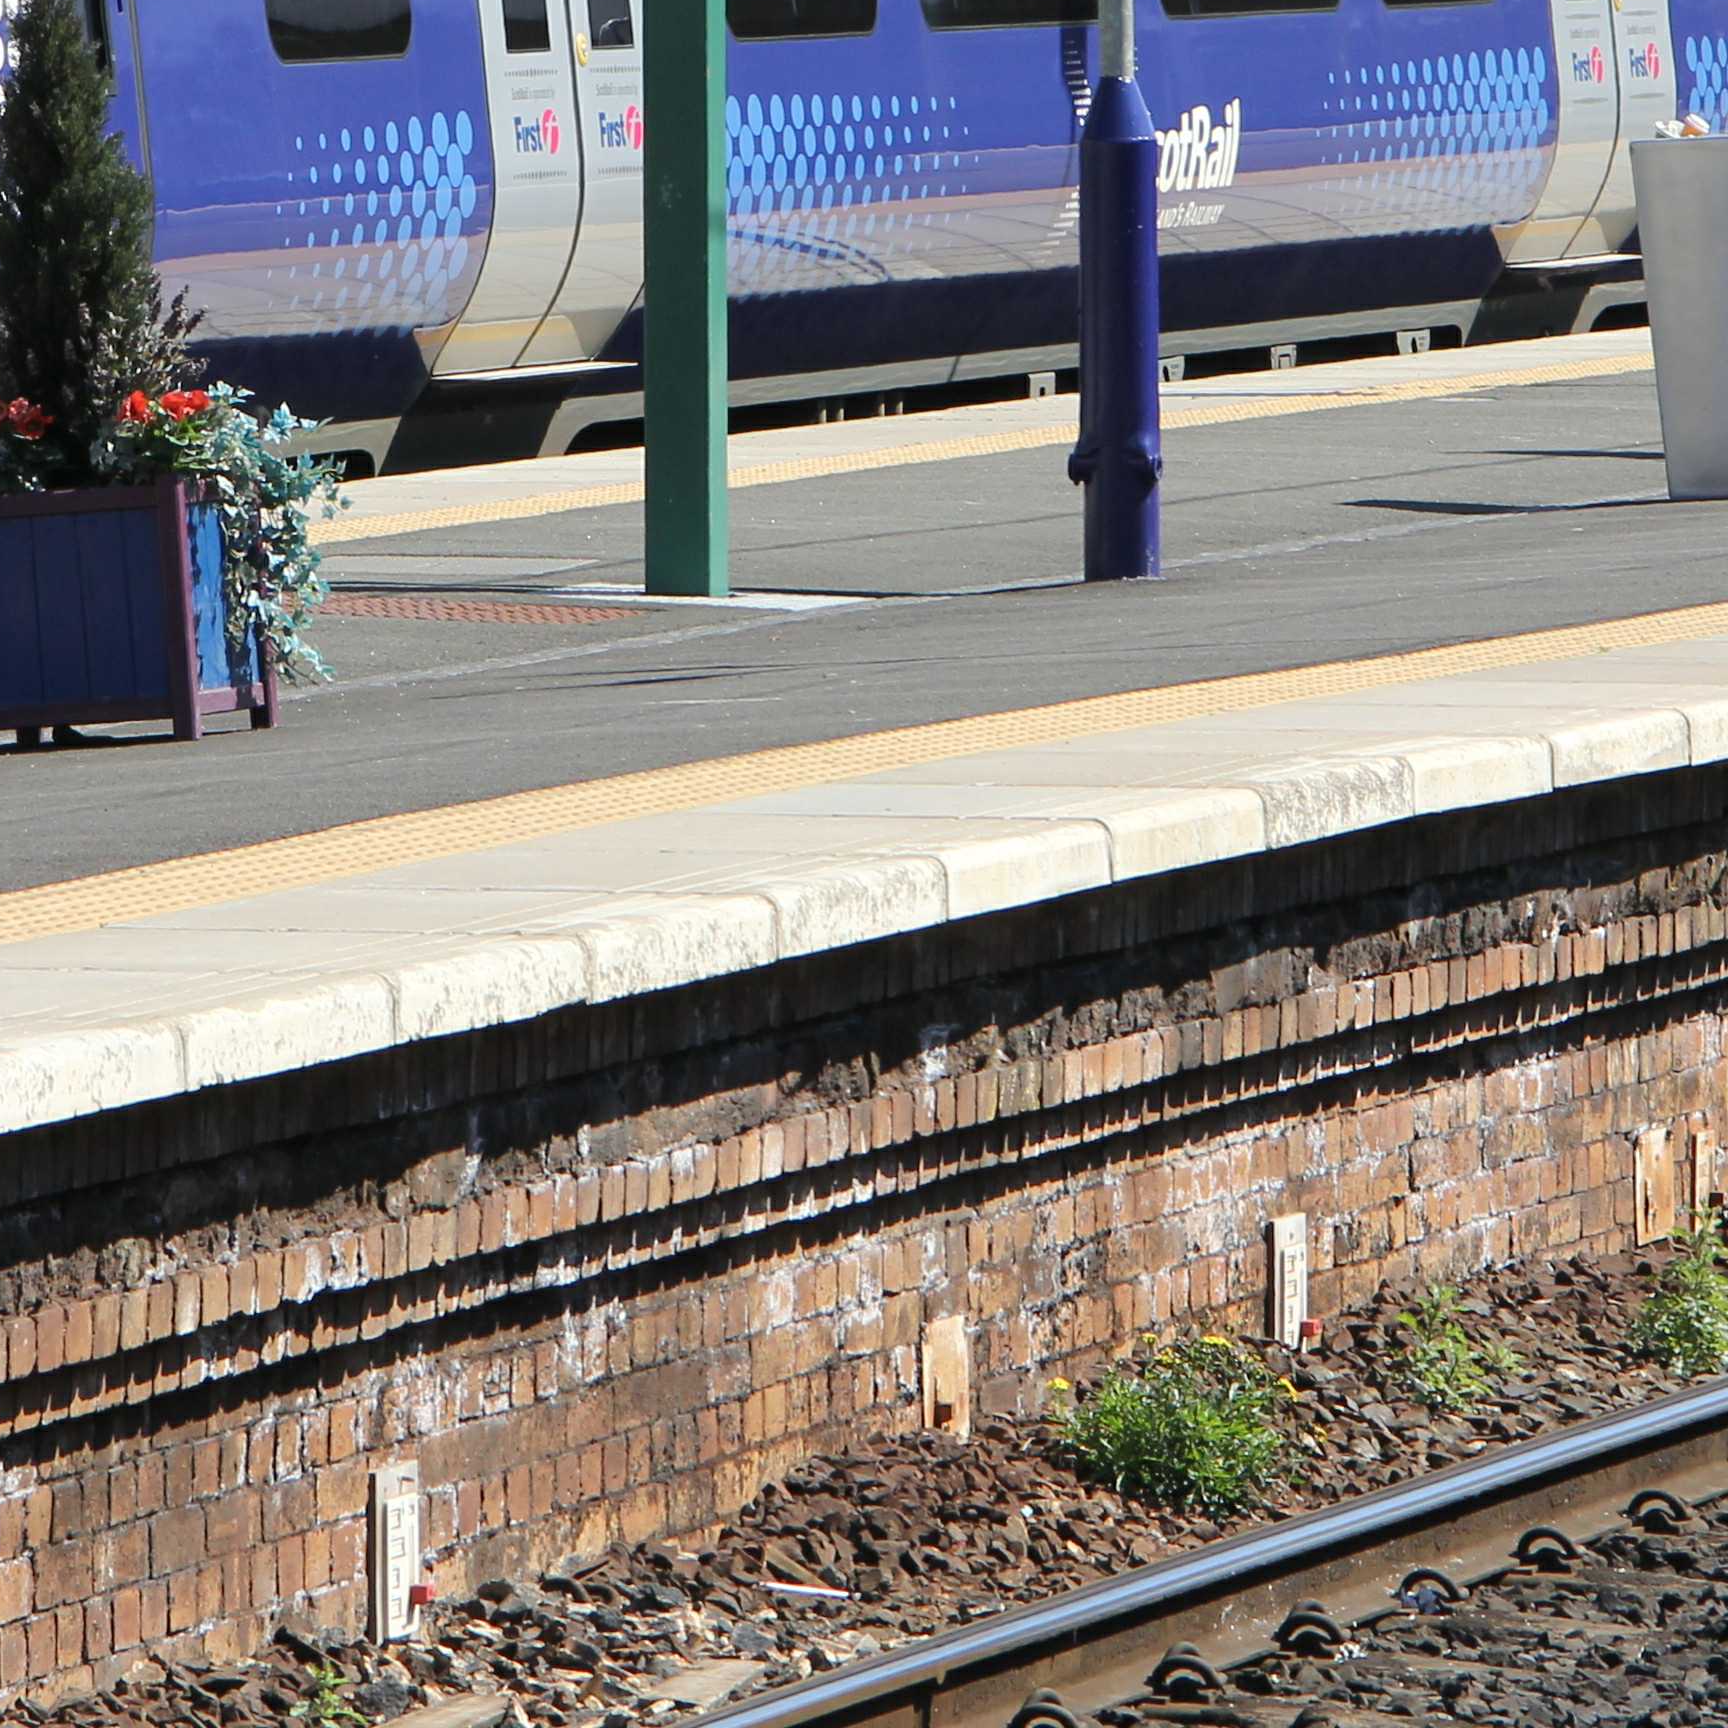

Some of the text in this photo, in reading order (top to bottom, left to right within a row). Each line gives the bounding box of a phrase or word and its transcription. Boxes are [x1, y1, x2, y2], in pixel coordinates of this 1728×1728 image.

[1571, 51, 1593, 83] First
[1628, 47, 1649, 78] First
[513, 115, 543, 154] First
[598, 111, 627, 148] First
